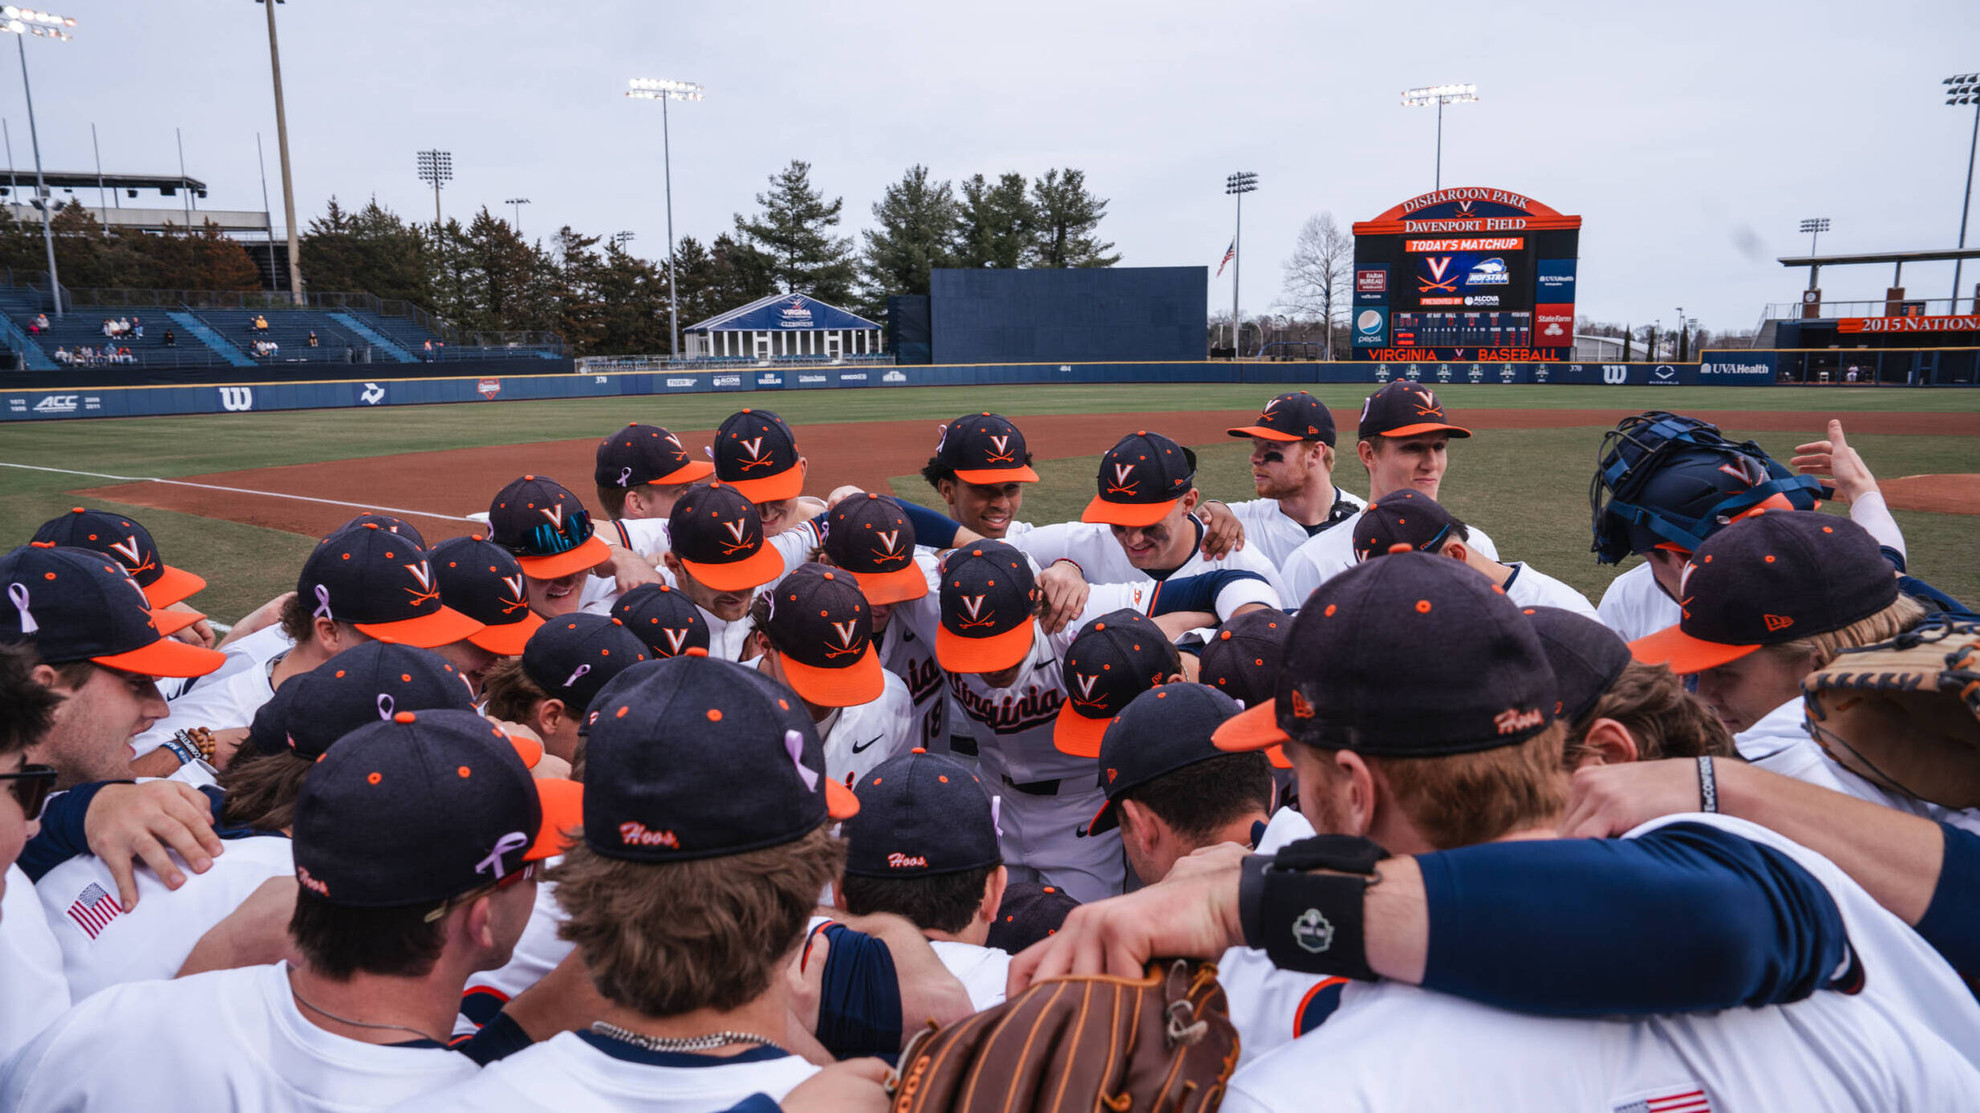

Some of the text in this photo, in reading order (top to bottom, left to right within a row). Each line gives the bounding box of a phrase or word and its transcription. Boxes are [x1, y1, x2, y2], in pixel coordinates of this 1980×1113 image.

[1403, 188, 1530, 213] DISHAROON PARK
[1405, 218, 1527, 233] DAVENPORT FIELD
[1412, 238, 1518, 251] TODAY'S MATCHUP
[1469, 273, 1508, 282] HOFSTRA
[1861, 319, 1901, 331] 2015
[1368, 348, 1560, 361] VIRGINIA BASEBALL
[36, 395, 79, 407] ACC
